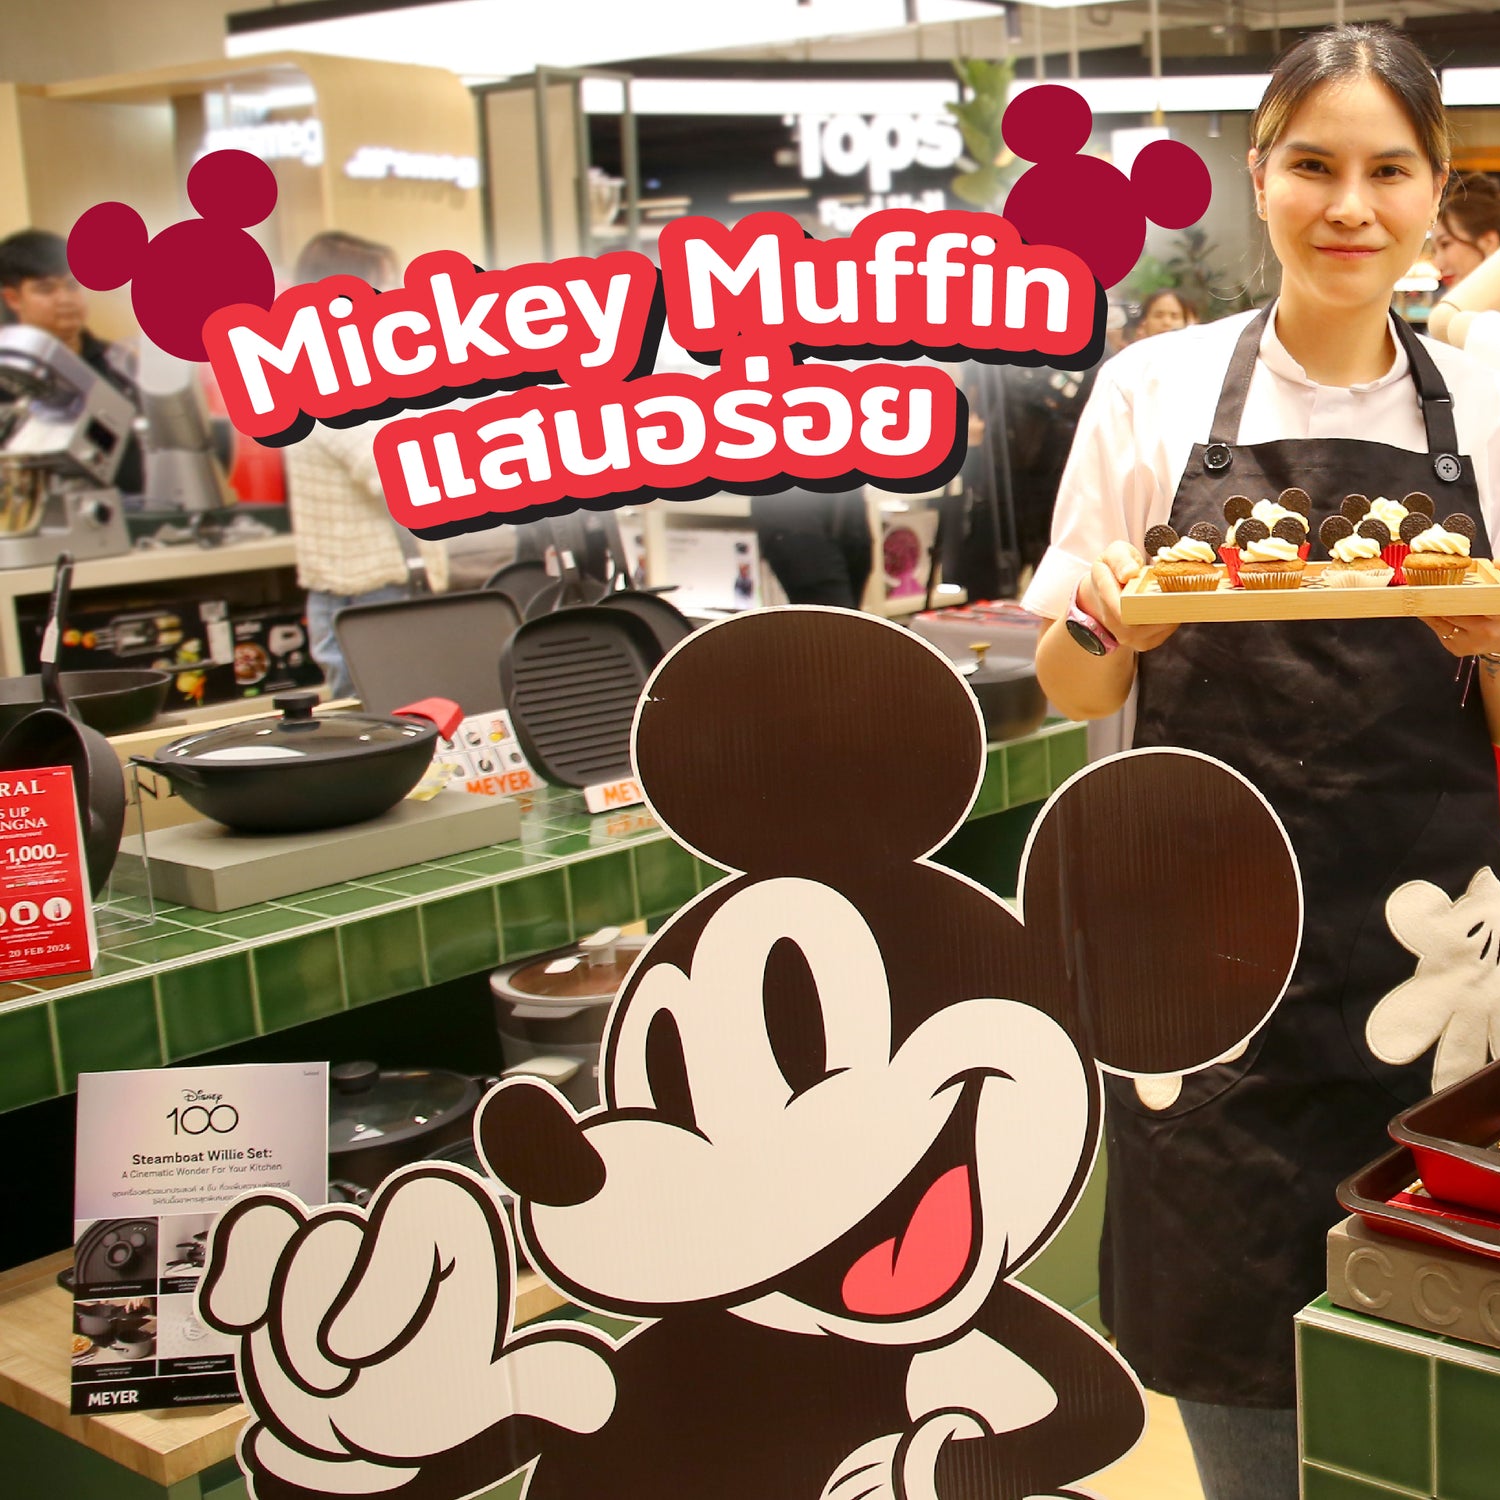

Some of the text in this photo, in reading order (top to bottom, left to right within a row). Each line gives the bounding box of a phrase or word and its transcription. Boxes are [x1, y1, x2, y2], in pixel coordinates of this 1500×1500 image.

[466, 770, 533, 796] MEYER
[603, 781, 642, 807] MEY
[9, 806, 31, 819] UP
[6, 844, 57, 866] 1,000
[166, 1103, 239, 1135] 100
[132, 1147, 273, 1166] Steamboat Willie Set:
[121, 1162, 283, 1179] A Cinematic Wonder For Your Kitchen
[88, 1389, 139, 1407] MEYER
